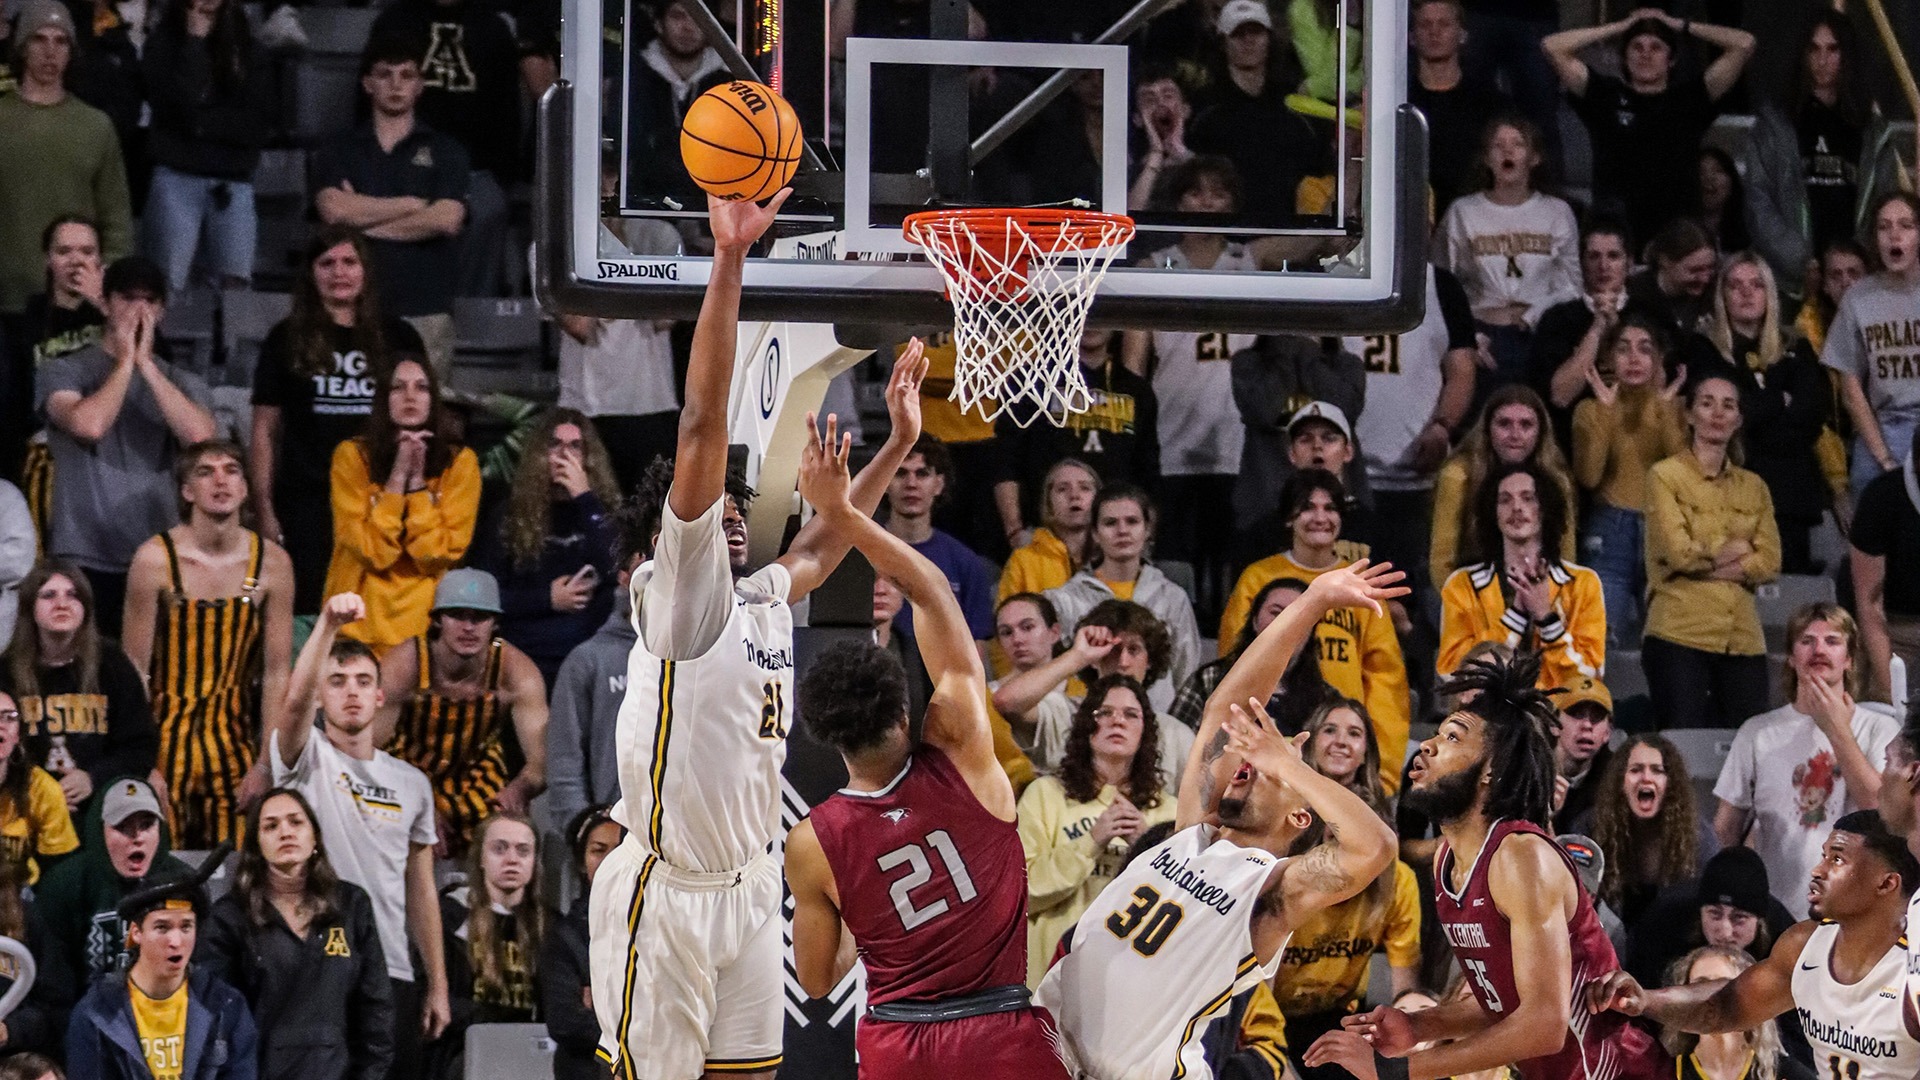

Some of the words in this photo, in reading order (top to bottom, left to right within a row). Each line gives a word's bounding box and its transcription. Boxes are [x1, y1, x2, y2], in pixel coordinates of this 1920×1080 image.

[422, 22, 476, 91] A
[597, 261, 680, 282] SPALDING
[1083, 429, 1104, 452] A
[609, 674, 628, 693] N
[46, 693, 108, 735] STATE
[758, 680, 787, 739] 21
[1063, 815, 1099, 841] MO
[876, 828, 978, 932] 21
[1104, 882, 1186, 959] 30
[1452, 922, 1491, 948] CENTRAL
[323, 926, 352, 958] A
[1464, 958, 1504, 1013] 35
[1798, 1006, 1898, 1058] Mountaineers
